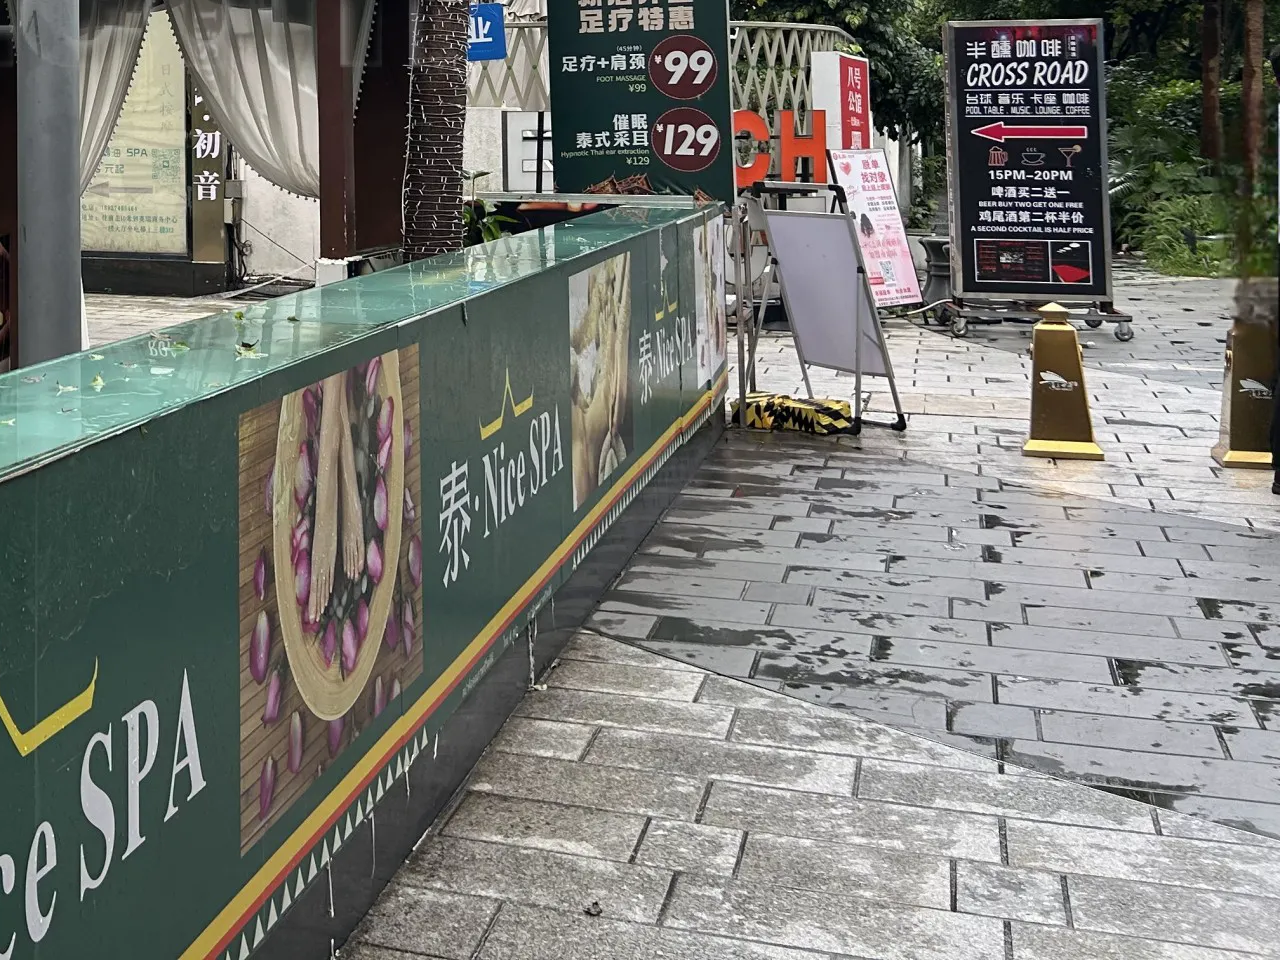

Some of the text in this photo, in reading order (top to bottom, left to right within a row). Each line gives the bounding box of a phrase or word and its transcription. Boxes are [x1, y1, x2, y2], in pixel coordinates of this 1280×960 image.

[578, 6, 695, 33] 足疗特惠
[615, 74, 646, 82] MASSAGE
[966, 60, 1089, 87] CROSS ROAD
[966, 93, 1090, 105] 台球 音乐 卡座 咖啡
[965, 106, 982, 115] POOL
[983, 106, 1004, 114] TABLE
[1065, 106, 1090, 114] COFFEE
[612, 113, 648, 131] 催眠
[576, 130, 649, 149] 泰式采耳
[126, 148, 148, 157] SPA
[561, 150, 589, 158] Hypnotic
[991, 186, 1070, 199] 啤酒买二送一
[978, 210, 1085, 224] 鸡尾酒第二杯半价
[675, 312, 693, 367] SPA
[482, 440, 527, 540] Nice
[528, 403, 565, 497] SPA
[79, 667, 207, 902] SPA
